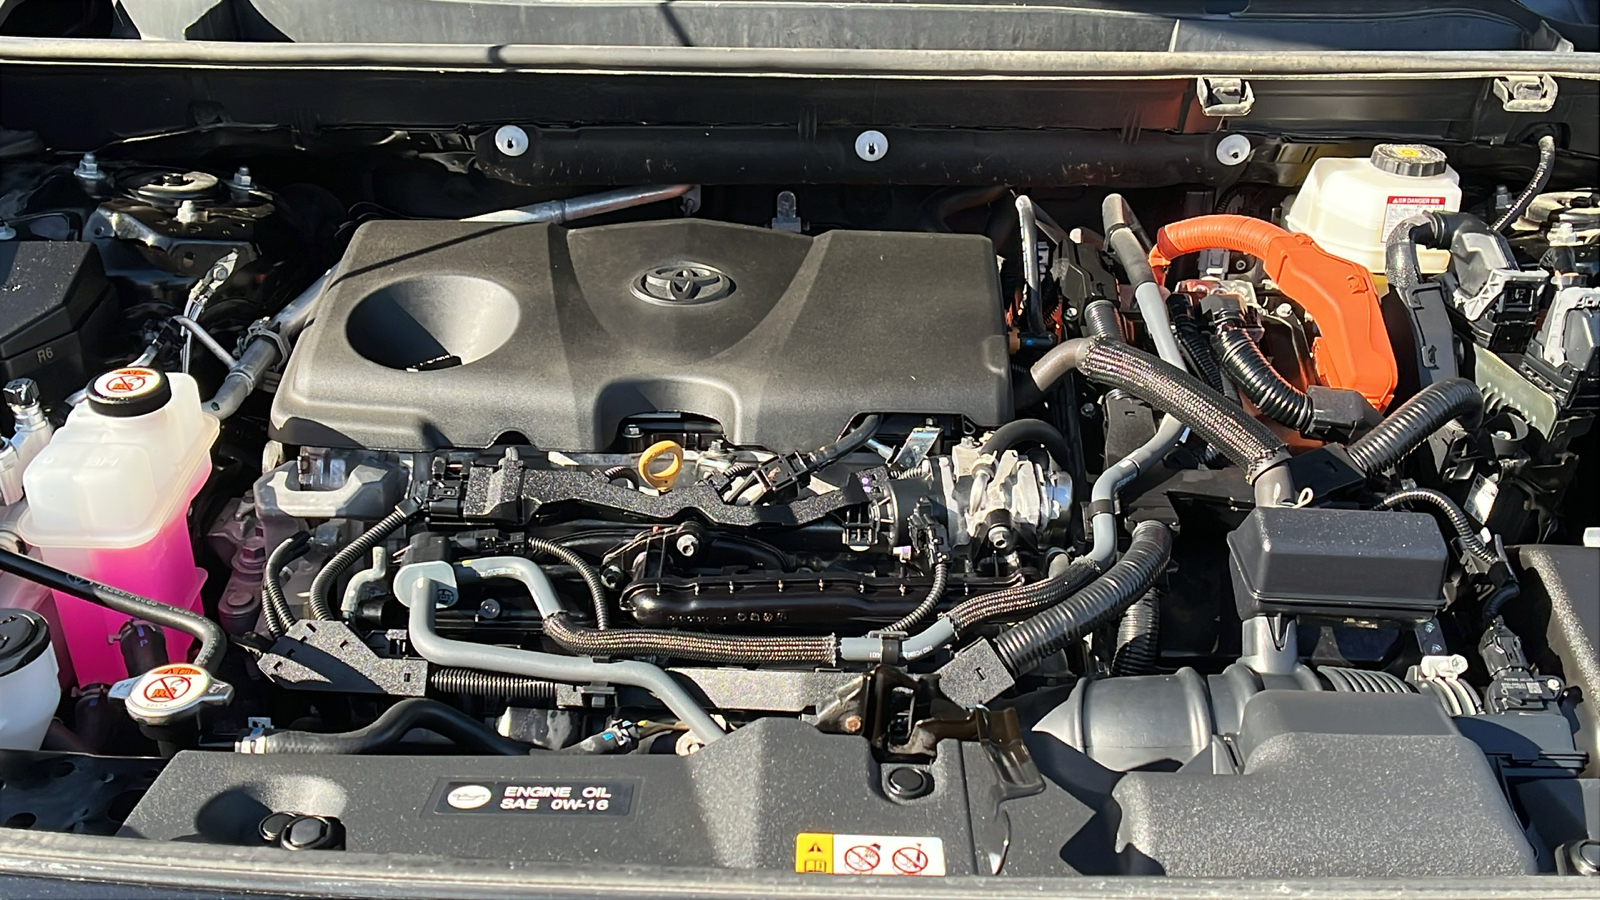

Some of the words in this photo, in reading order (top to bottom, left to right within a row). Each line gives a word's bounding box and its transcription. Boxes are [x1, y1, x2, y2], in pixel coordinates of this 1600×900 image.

[504, 786, 572, 798] ENGINE
[582, 786, 612, 798] OIL
[500, 798, 539, 809] SAE
[550, 799, 609, 811] 0W-16
